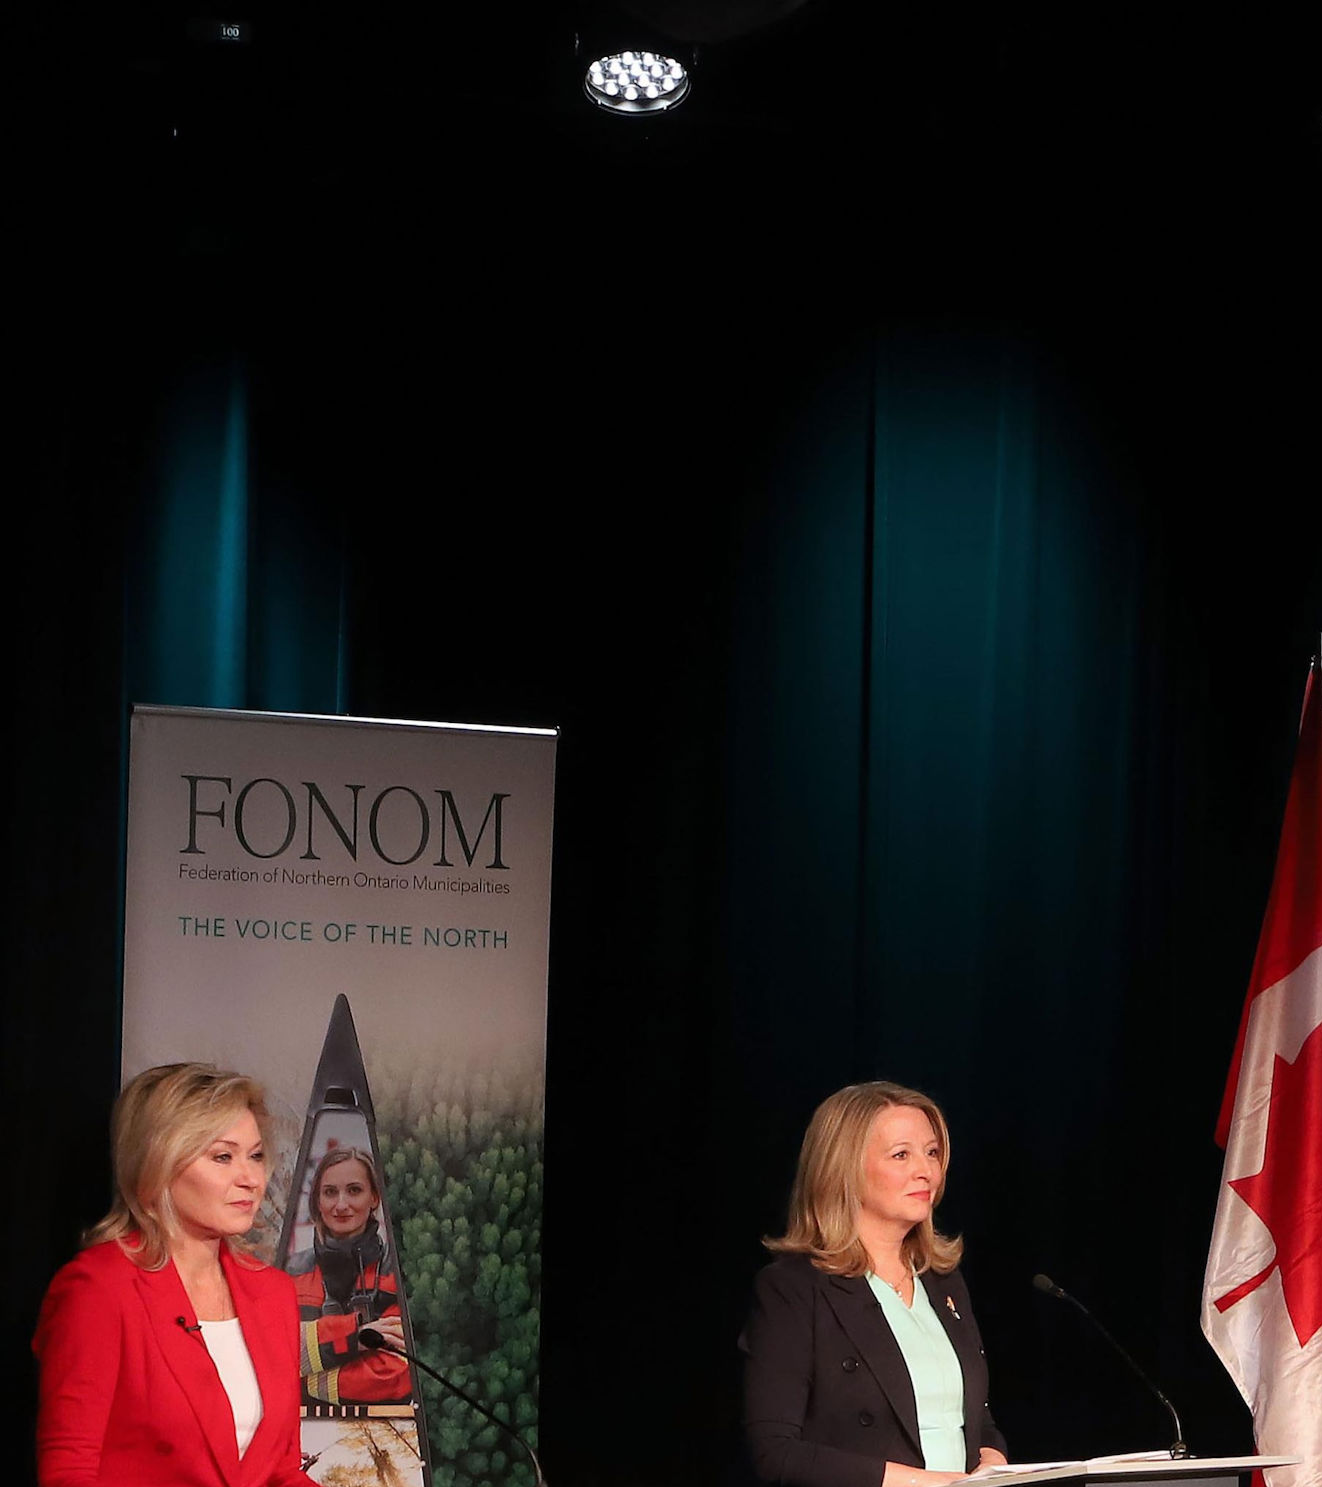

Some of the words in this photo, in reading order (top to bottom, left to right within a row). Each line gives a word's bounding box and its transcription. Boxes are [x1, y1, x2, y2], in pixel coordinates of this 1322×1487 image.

[179, 775, 511, 869] FONOM
[178, 863, 259, 883] Federation
[262, 867, 279, 883] of
[282, 868, 350, 887] Northern
[353, 871, 409, 890] Ontario
[412, 875, 510, 896] Municipalities
[178, 916, 225, 937] THE
[236, 919, 312, 941] VOICE
[323, 922, 357, 943] OF
[366, 925, 413, 945] THE
[424, 927, 508, 949] NORTH
